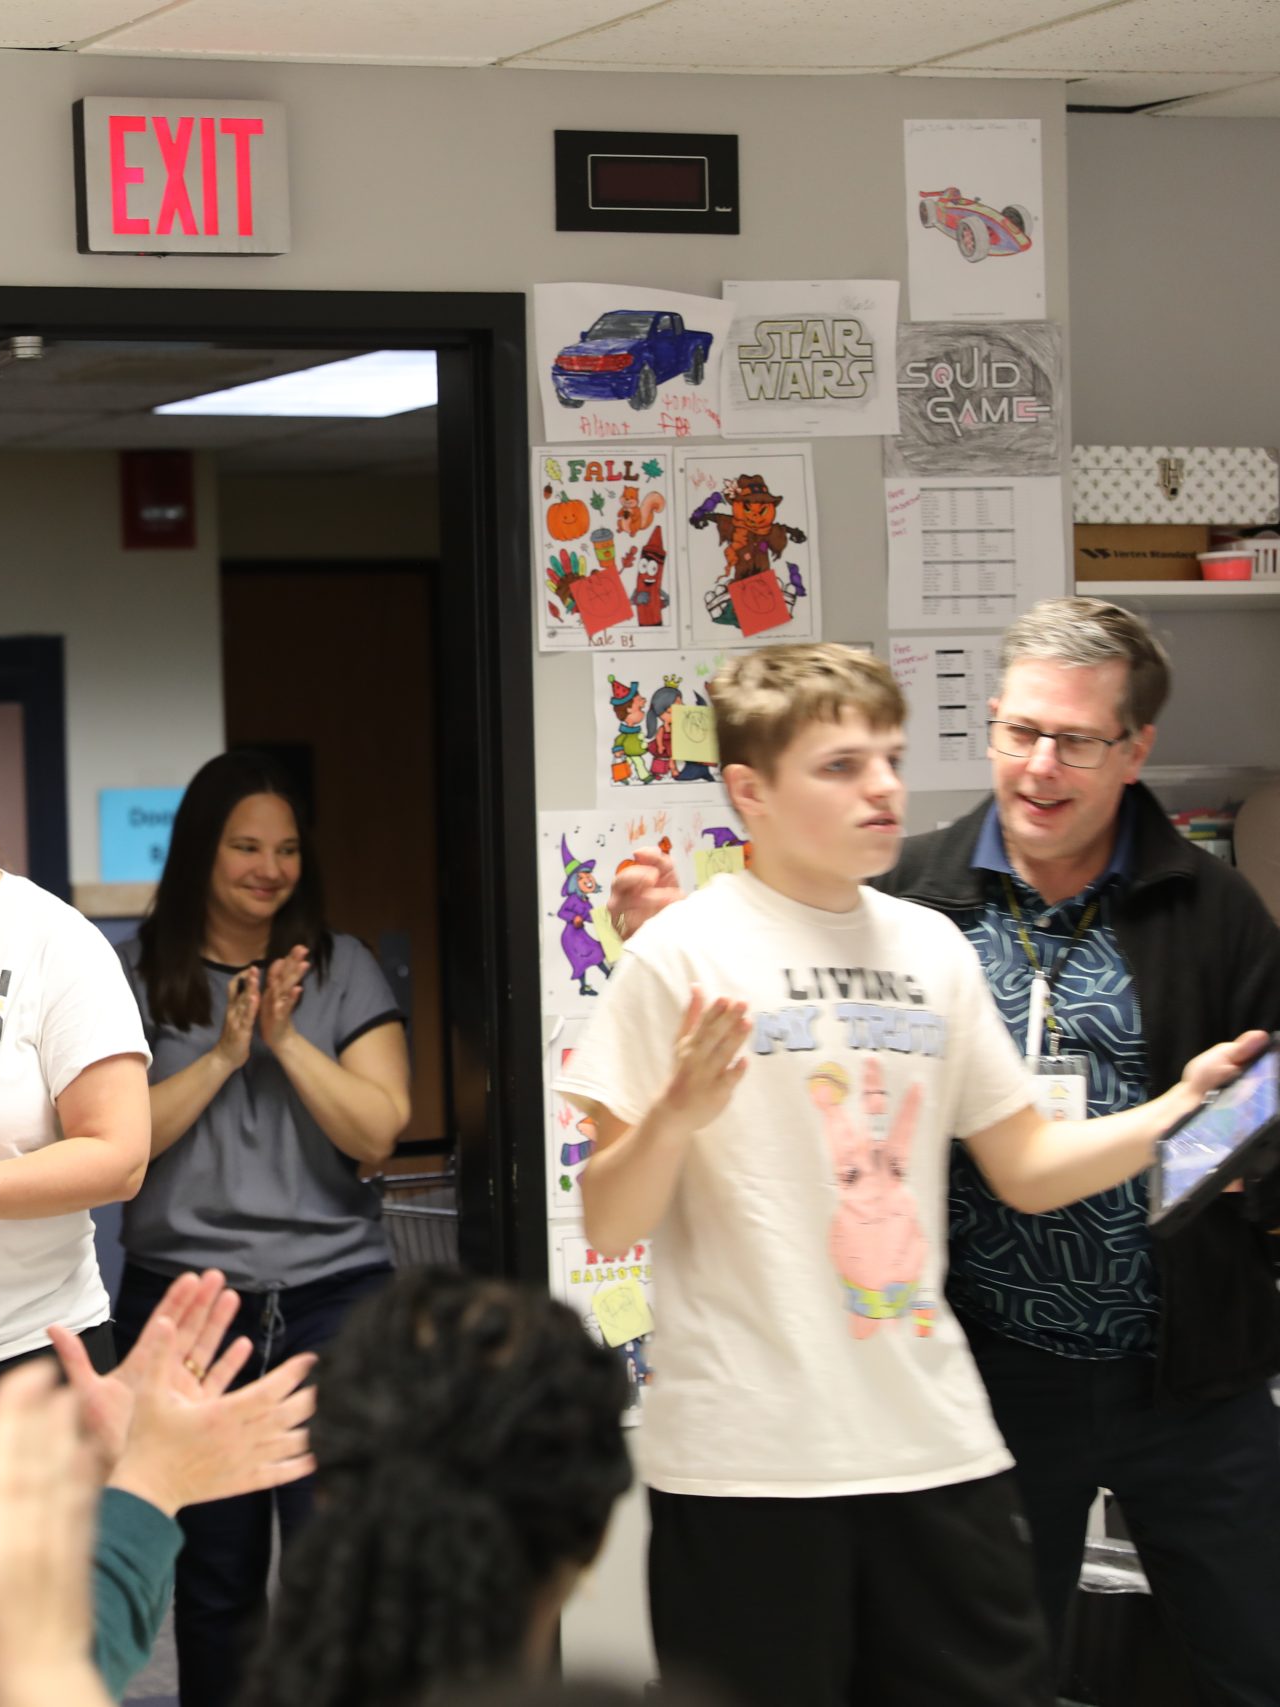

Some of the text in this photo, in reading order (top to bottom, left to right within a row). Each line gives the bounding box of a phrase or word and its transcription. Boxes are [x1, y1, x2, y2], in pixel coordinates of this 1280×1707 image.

[108, 115, 264, 236] EXIT
[738, 319, 872, 360] STAR
[738, 360, 873, 400] WARS
[897, 348, 1021, 396] SQUID
[926, 397, 1051, 437] GAME
[568, 460, 640, 482] FALL
